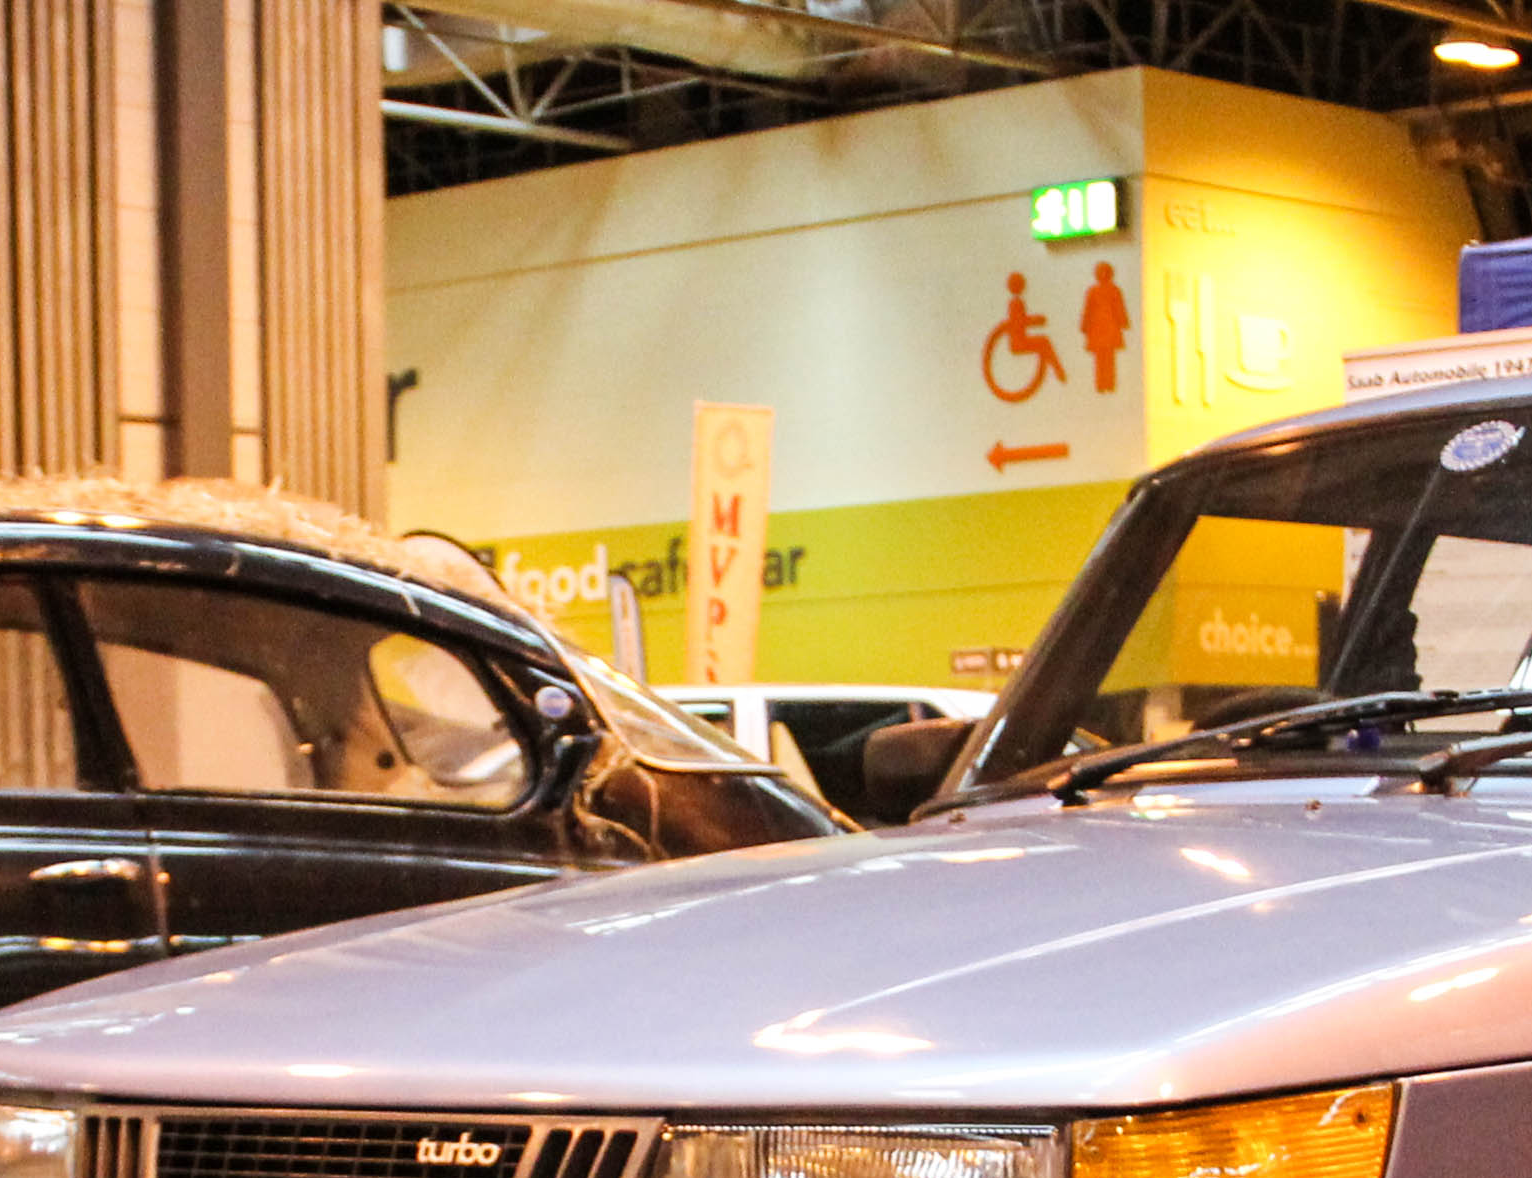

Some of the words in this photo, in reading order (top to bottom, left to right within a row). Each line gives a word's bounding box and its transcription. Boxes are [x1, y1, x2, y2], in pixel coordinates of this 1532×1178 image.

[503, 543, 609, 602] food
[618, 538, 688, 598] caf
[760, 546, 805, 588] ar
[416, 1131, 503, 1167] turbo
